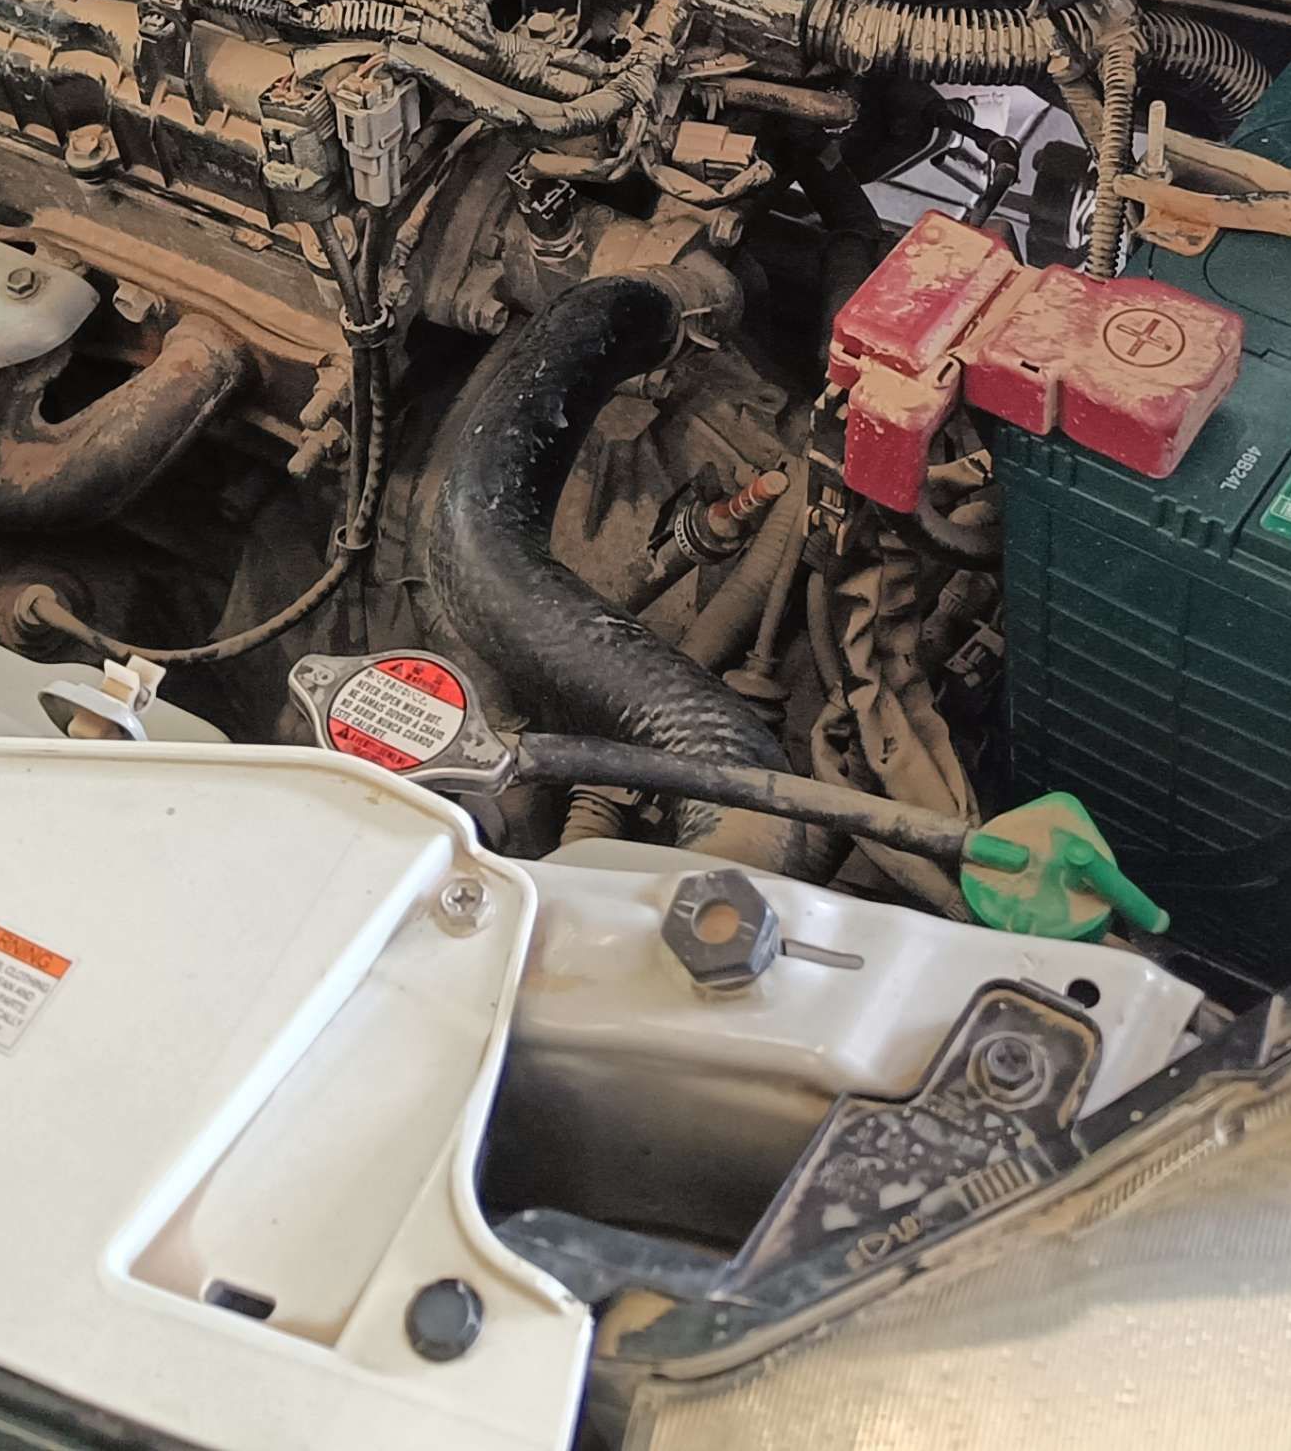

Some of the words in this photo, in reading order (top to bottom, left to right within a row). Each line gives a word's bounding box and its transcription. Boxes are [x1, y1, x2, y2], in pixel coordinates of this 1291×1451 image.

[1219, 445, 1262, 490] 46B24L
[675, 520, 695, 558] ONLY
[332, 708, 352, 721] ESTE
[348, 689, 360, 699] NE
[359, 694, 386, 713] JAMAIS
[385, 707, 413, 725] OUVRIR
[356, 679, 382, 696] NEVER
[381, 690, 402, 707] OPEN
[402, 702, 425, 718] WHEN
[340, 698, 353, 708] NO
[352, 704, 376, 721] ABRIR
[376, 716, 402, 734] NUNCA
[402, 728, 435, 748] CUANDO
